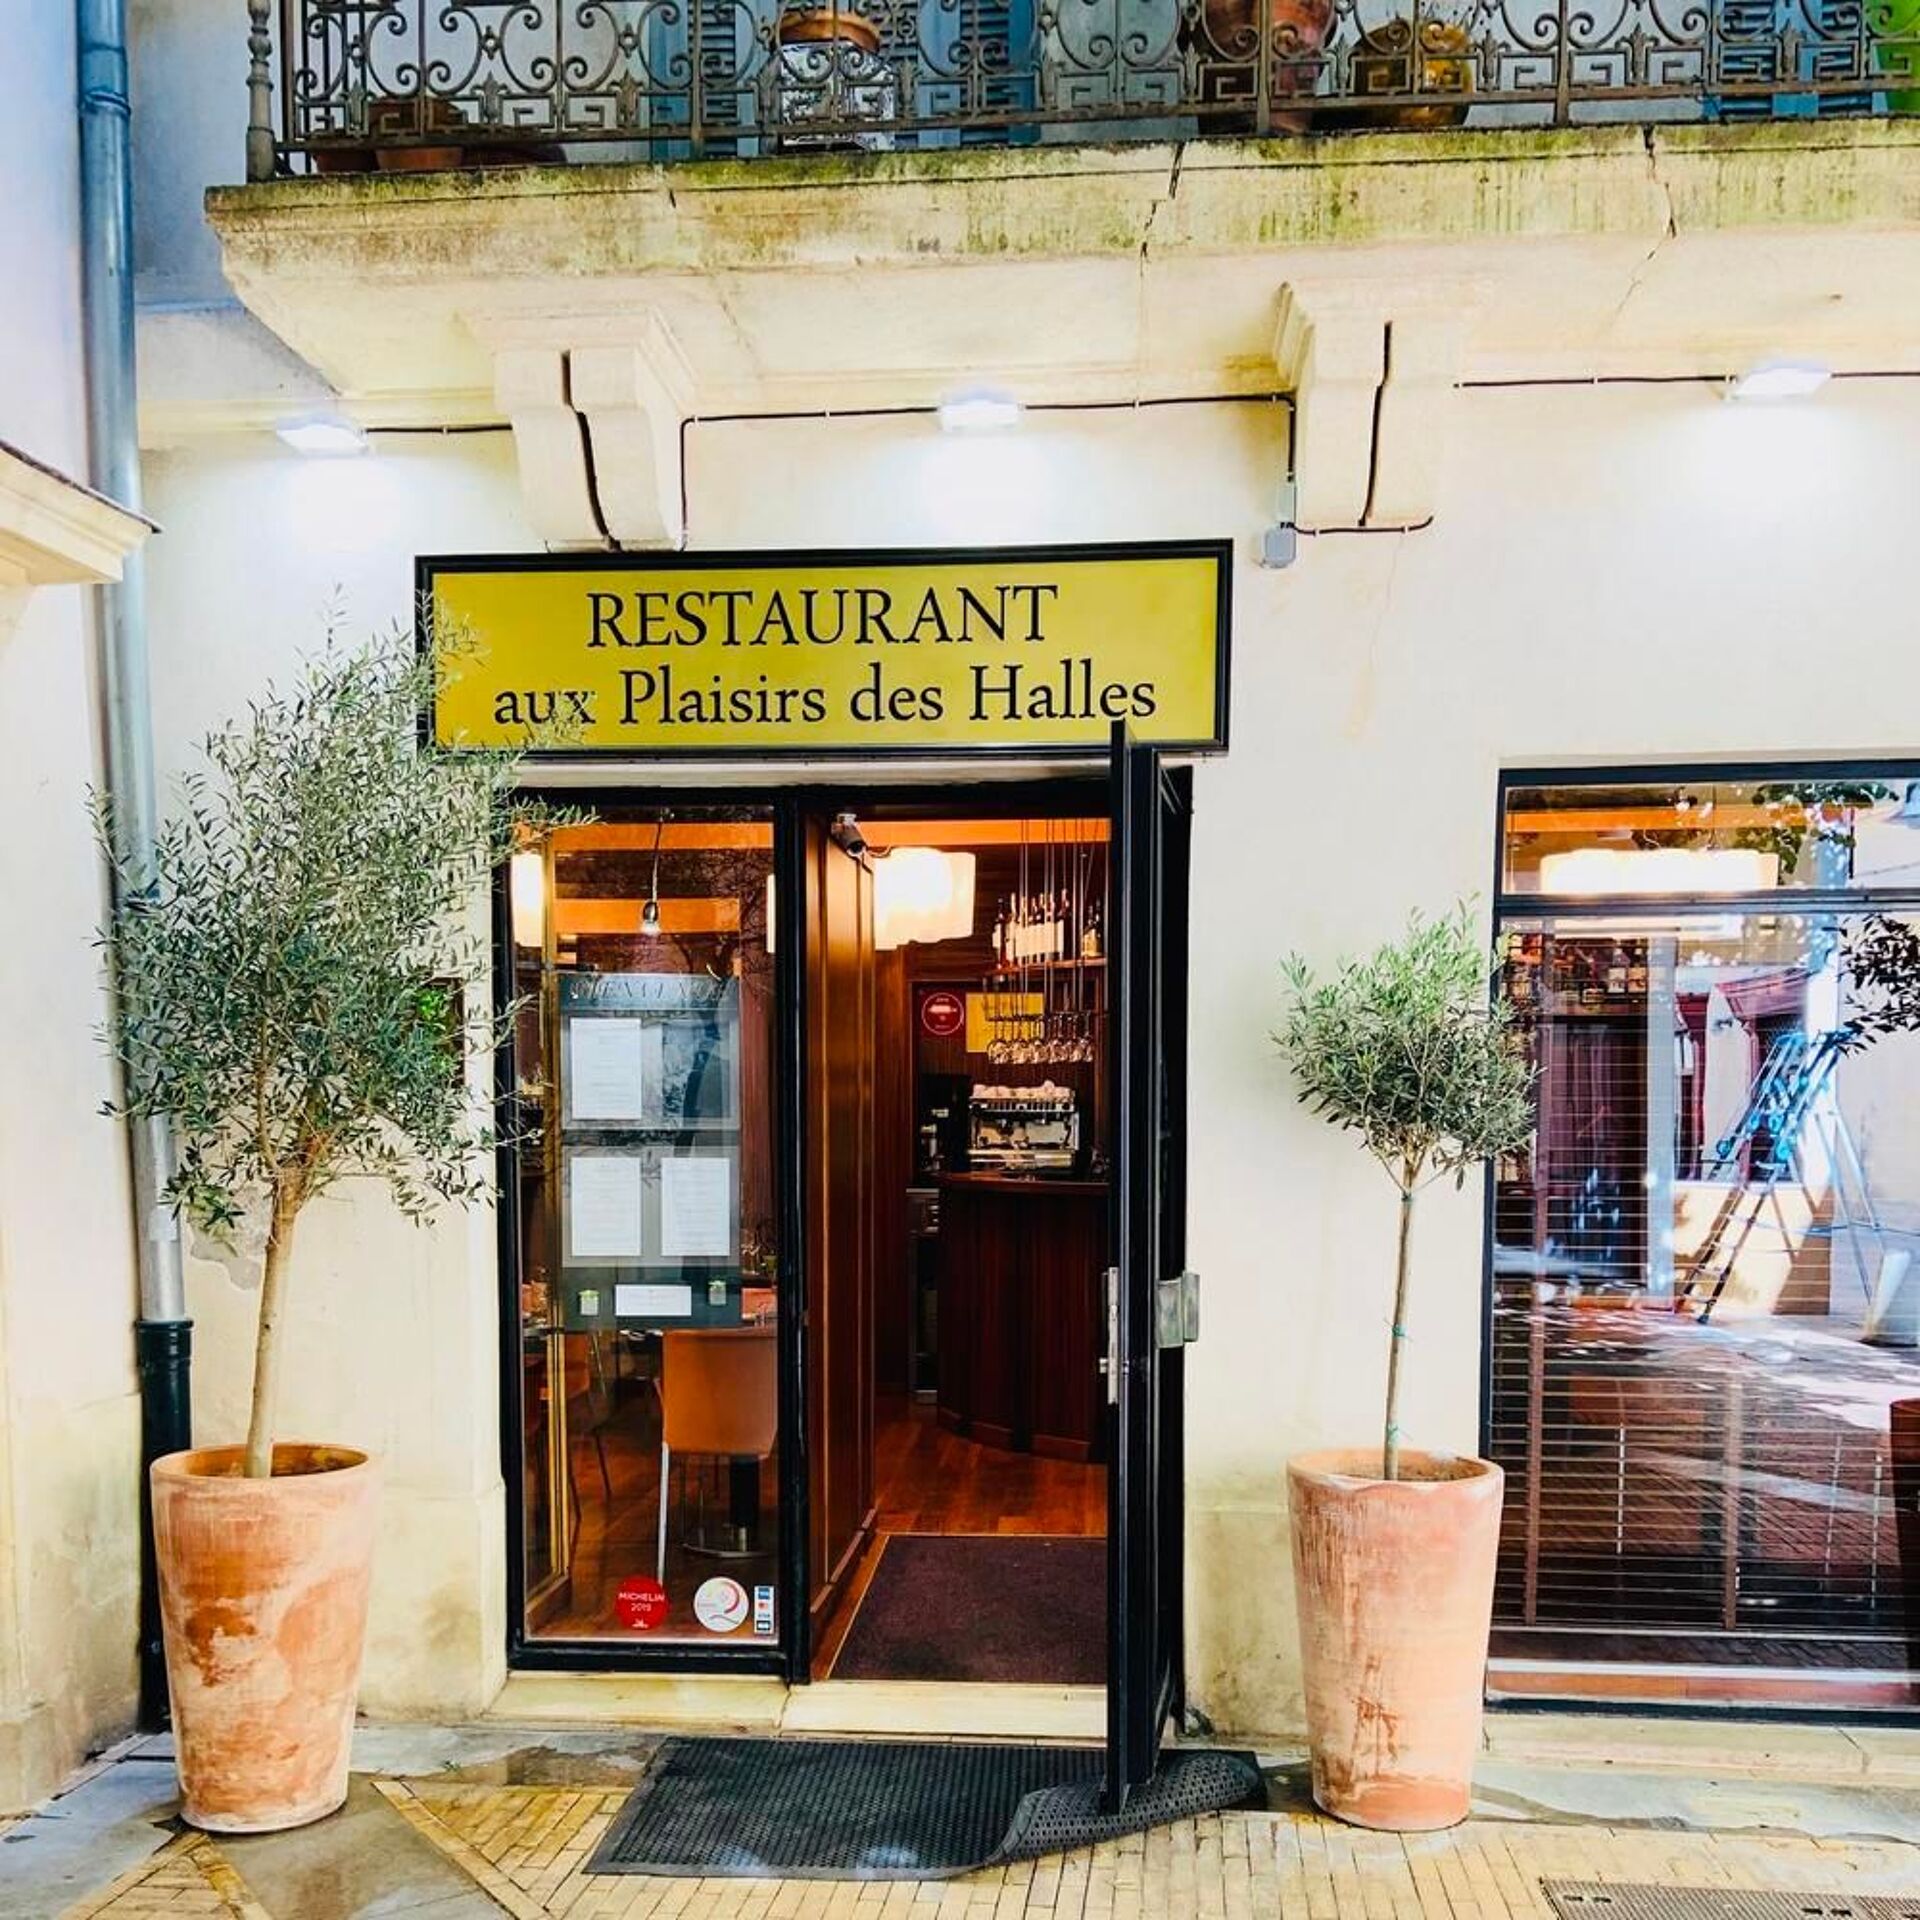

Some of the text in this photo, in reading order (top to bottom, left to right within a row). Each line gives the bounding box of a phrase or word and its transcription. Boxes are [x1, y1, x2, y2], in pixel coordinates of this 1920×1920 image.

[586, 584, 1058, 649] RESTAURANT
[494, 658, 1157, 725] aux Plaisirs des Halles
